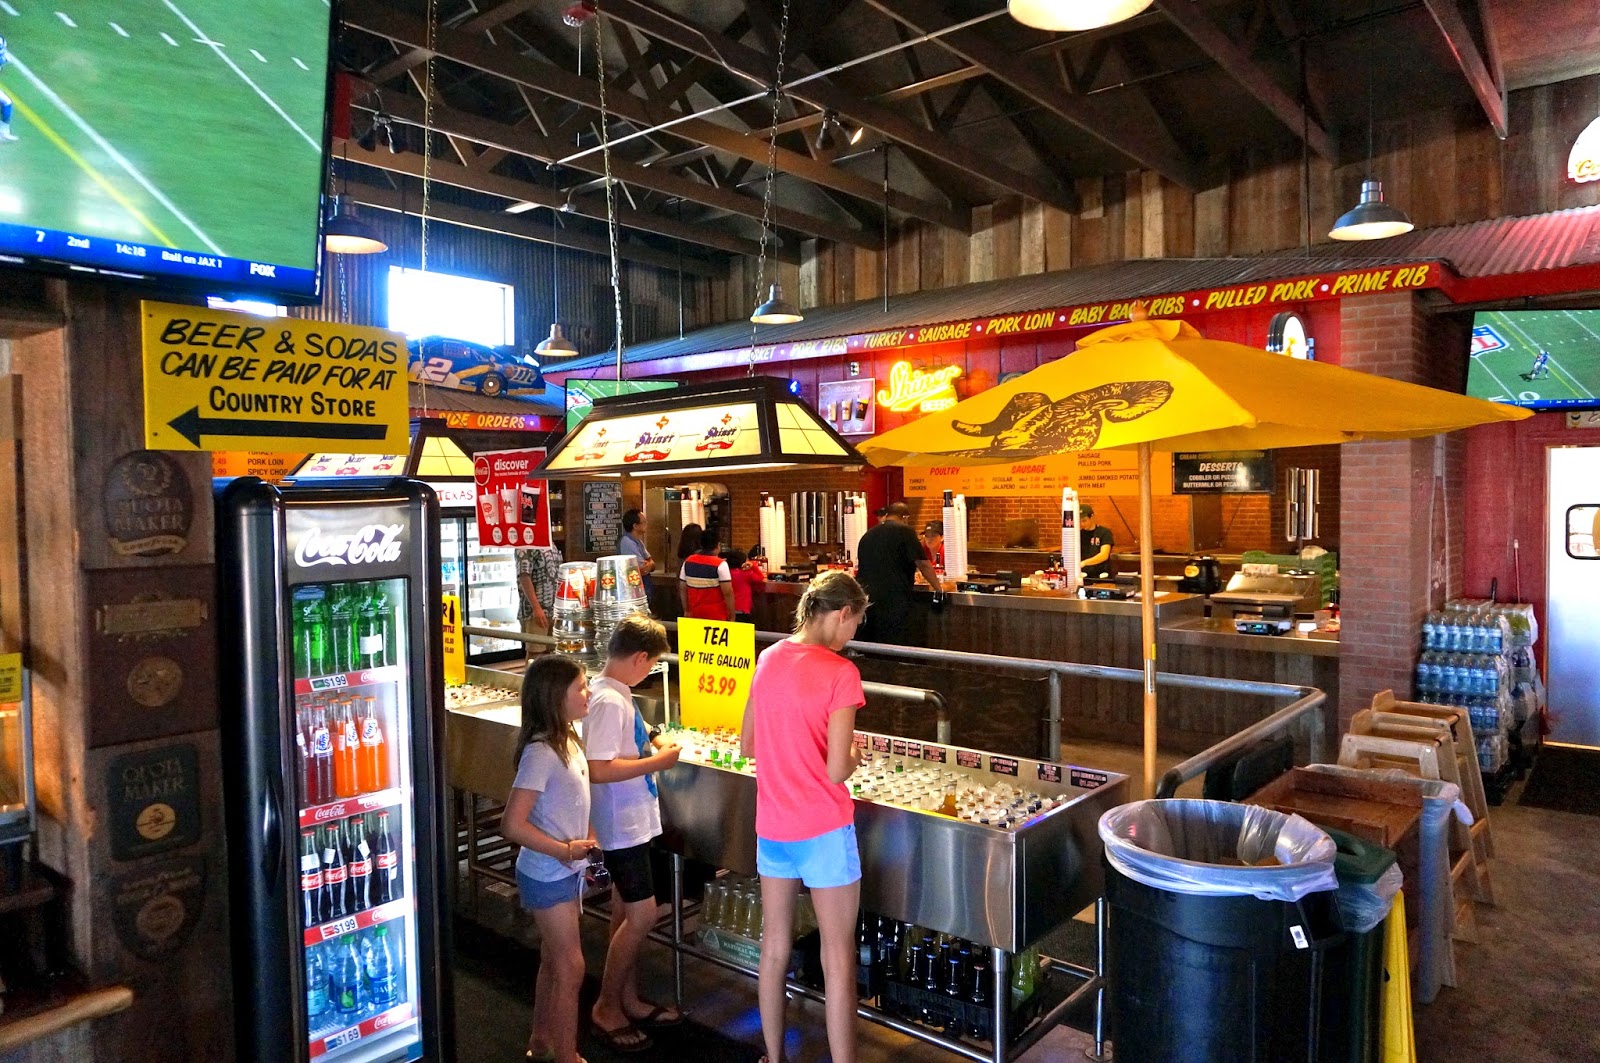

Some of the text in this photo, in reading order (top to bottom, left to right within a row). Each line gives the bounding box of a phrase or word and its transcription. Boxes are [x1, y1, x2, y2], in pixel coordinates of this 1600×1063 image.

[35, 230, 45, 243] 7
[67, 236, 90, 249] 2nd
[183, 254, 197, 265] on
[250, 262, 275, 277] FOX
[790, 341, 817, 357] PORK
[821, 338, 848, 352] RIBS
[863, 331, 906, 348] TURKEY
[917, 322, 972, 343] SAUSAGE
[985, 317, 1021, 335] PORK
[1024, 312, 1055, 331] LOIN
[1069, 305, 1109, 326] BABY
[1148, 296, 1185, 317] RIBS
[1205, 285, 1267, 310] PULLED
[1270, 278, 1320, 302] PORK
[1331, 270, 1392, 295] PRIME
[1392, 265, 1430, 288] RIB
[160, 318, 397, 365] BEER & SODAS
[160, 351, 398, 391] CAN BE PAID FOR AT
[427, 357, 453, 383] 2
[877, 361, 963, 407] Shiner
[477, 414, 526, 429] ORDERS
[635, 431, 675, 449] Shiner
[704, 426, 737, 441] Shiner
[247, 468, 288, 476] SPICY CHOP
[494, 459, 529, 471] discover
[930, 467, 961, 476] POULTRY
[1011, 465, 1046, 474] SAUSAGE
[1199, 462, 1244, 472] DESSERTS
[1183, 481, 1214, 489] BUTTERMILK
[436, 490, 474, 501] TEXAS
[294, 523, 405, 568] Coca-Cola
[703, 626, 729, 647] TEA
[683, 650, 751, 670] BY THE GALLON
[698, 673, 736, 697] $3.99
